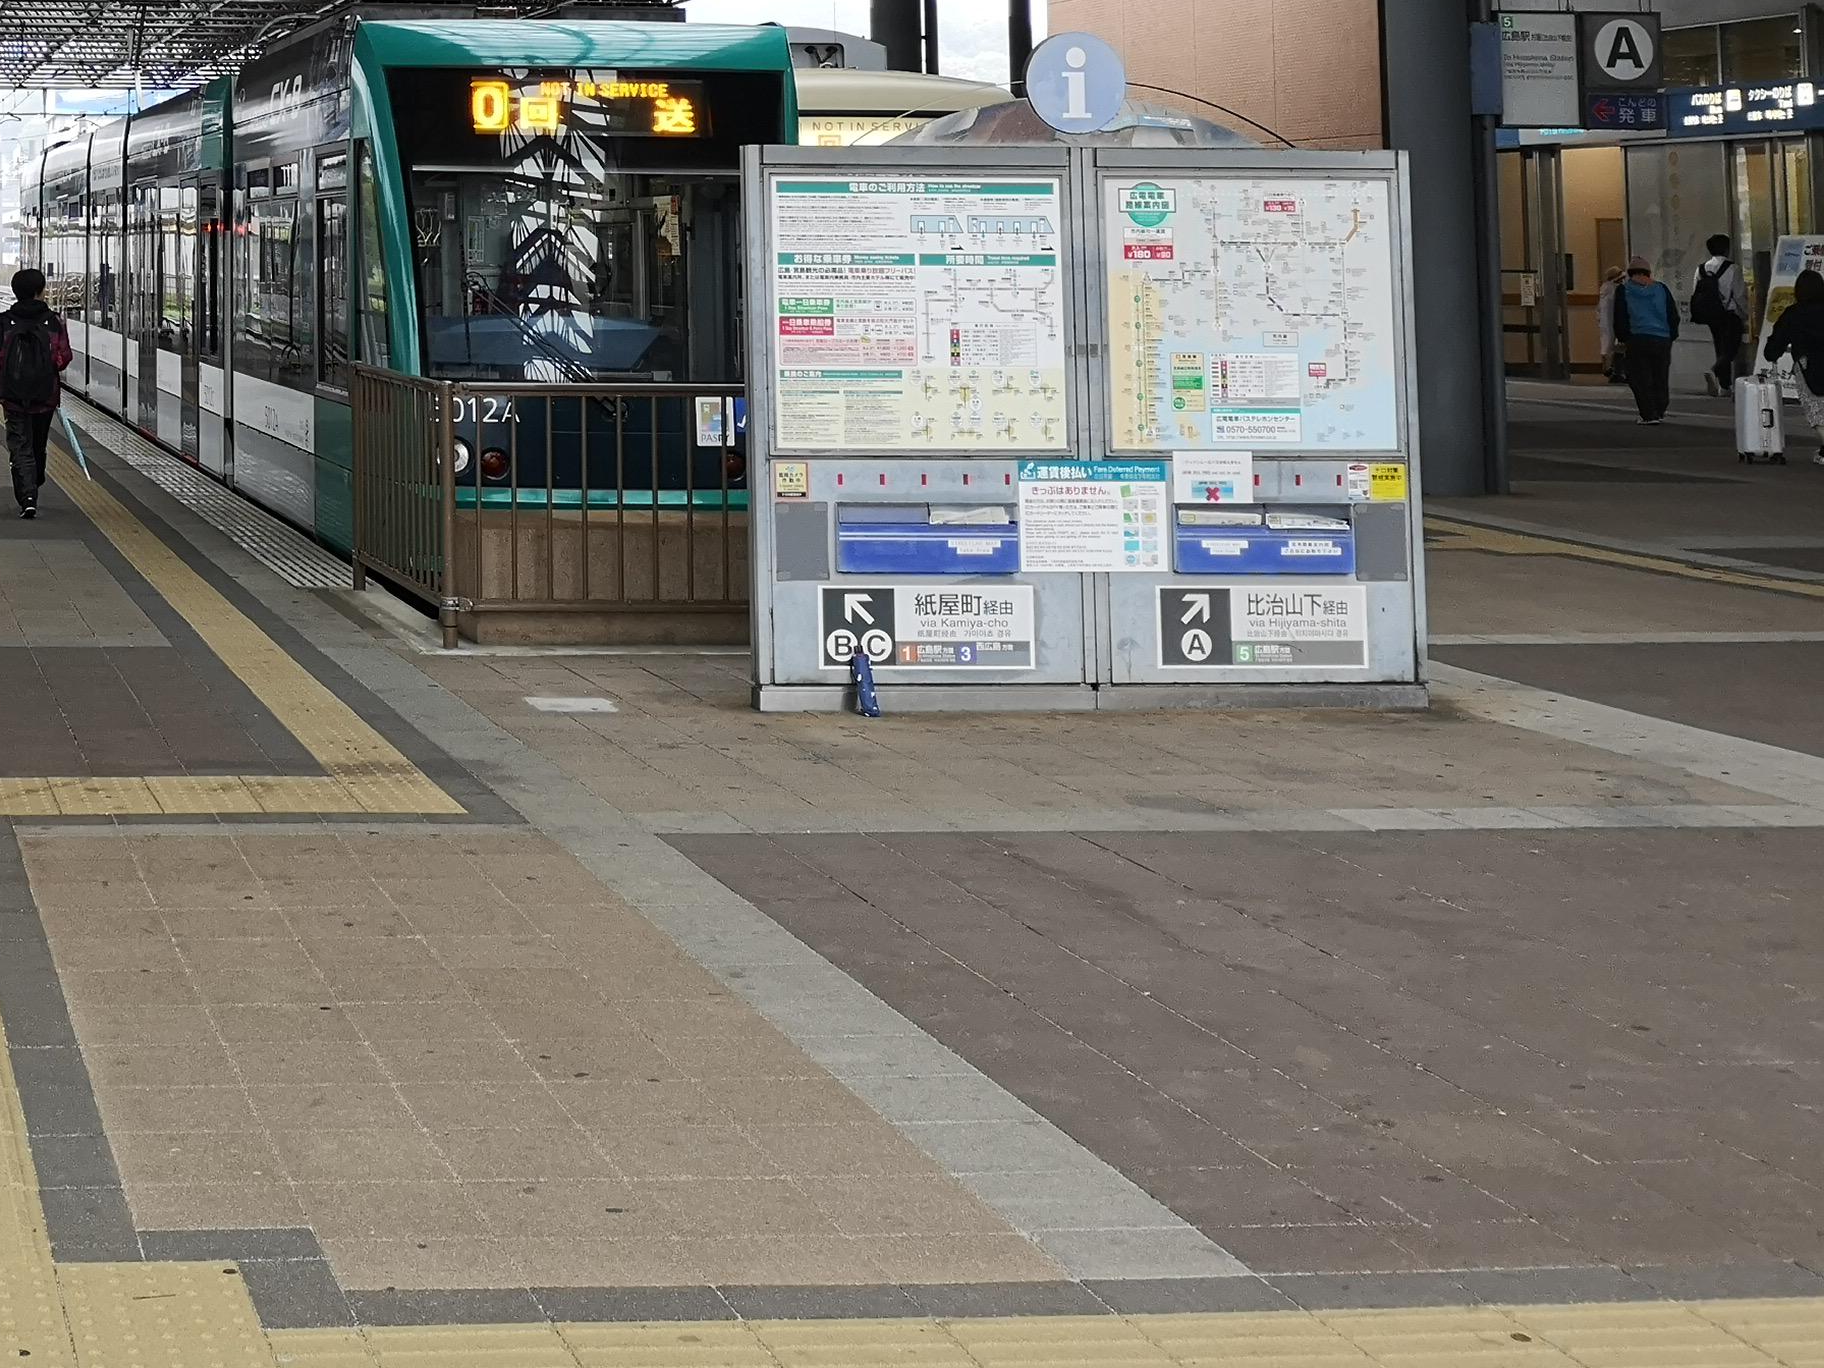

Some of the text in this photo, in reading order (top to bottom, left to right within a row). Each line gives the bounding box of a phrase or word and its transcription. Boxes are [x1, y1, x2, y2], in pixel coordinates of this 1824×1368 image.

[1503, 16, 1513, 27] 5
[1605, 26, 1645, 69] A
[540, 81, 669, 98] NOT IN SERVICE
[474, 84, 506, 128] 0
[1618, 97, 1657, 107] こんどの
[1691, 92, 1722, 106] バスのりば
[1618, 108, 1657, 124] 発車
[812, 121, 844, 131] NOT
[850, 122, 865, 131] IN
[848, 182, 926, 192] 電車のご利用方法
[793, 254, 852, 264] お得な乗車券
[945, 255, 985, 265] 所要時間
[430, 398, 521, 423] 012A
[1226, 425, 1276, 433] 0570-550700
[1037, 465, 1092, 480] 運賃後払い
[1093, 465, 1107, 473] Fare
[1134, 466, 1160, 474] Payment
[1031, 486, 1111, 496] きっぷはありません。
[914, 593, 1014, 616] 紙屋町経由
[1246, 593, 1348, 616] 比治山下経由
[920, 618, 1008, 630] via Kamiya-cho
[1250, 617, 1347, 630] via Hijiyama-shita
[834, 634, 886, 657] B C
[1187, 633, 1207, 655] A
[902, 646, 911, 661] 1
[917, 645, 955, 654] 広島駅方面
[961, 646, 972, 661] 3
[976, 642, 1014, 651] 西広島方面
[1239, 646, 1250, 661] 5
